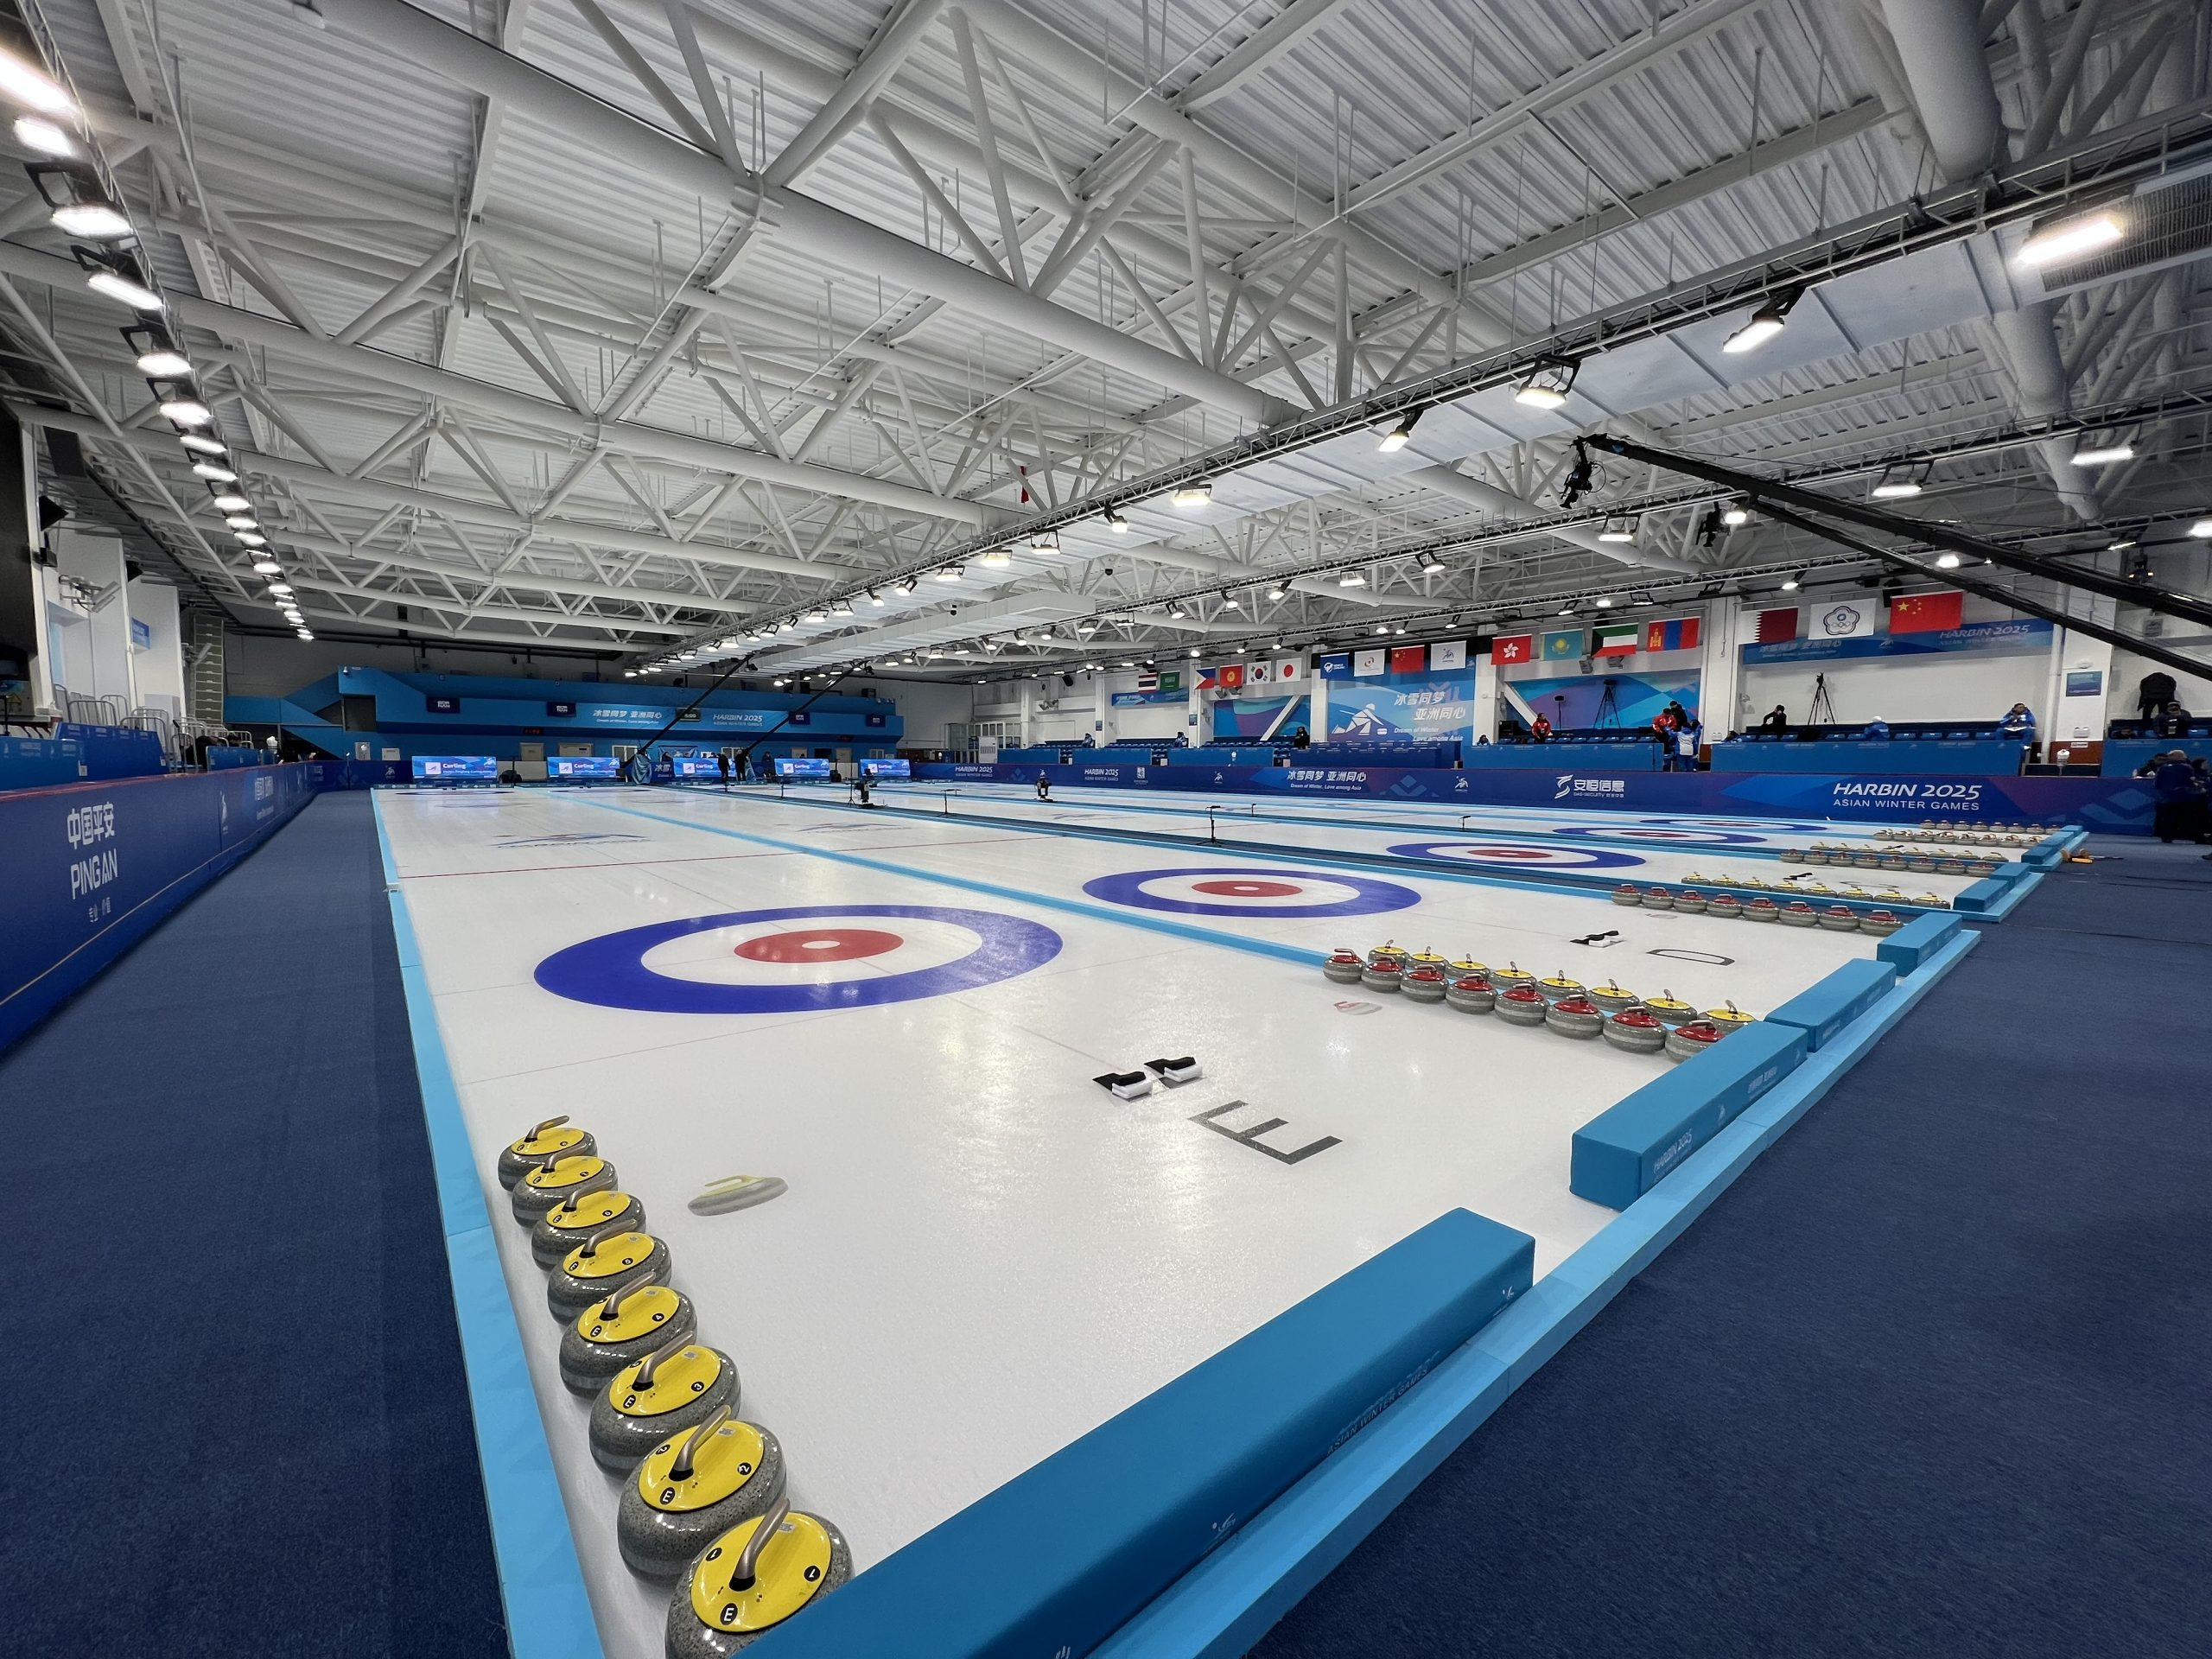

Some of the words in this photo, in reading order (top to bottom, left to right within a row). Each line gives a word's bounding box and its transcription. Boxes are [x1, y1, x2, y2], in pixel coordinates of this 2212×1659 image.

[1940, 628, 1991, 639] HARBIN
[1993, 625, 2031, 635] 2025
[1394, 691, 1445, 705] 冰雪同梦
[1413, 707, 1465, 720] 亚洲同心
[1287, 770, 1325, 781] 冰雪同梦
[1326, 771, 1366, 782] 亚洲同心
[1833, 783, 1917, 797] HARBIN
[1921, 785, 1982, 800] 2025
[1833, 798, 1870, 807] ASIAN
[1875, 800, 1925, 809] WINTER
[1930, 801, 1980, 810] GAMES
[67, 802, 115, 849] 中国平安
[1187, 1100, 1344, 1165] E
[591, 1327, 601, 1336] E
[625, 1397, 633, 1407] E
[738, 1465, 750, 1473] 2
[662, 1491, 673, 1503] E
[723, 1607, 734, 1622] E
